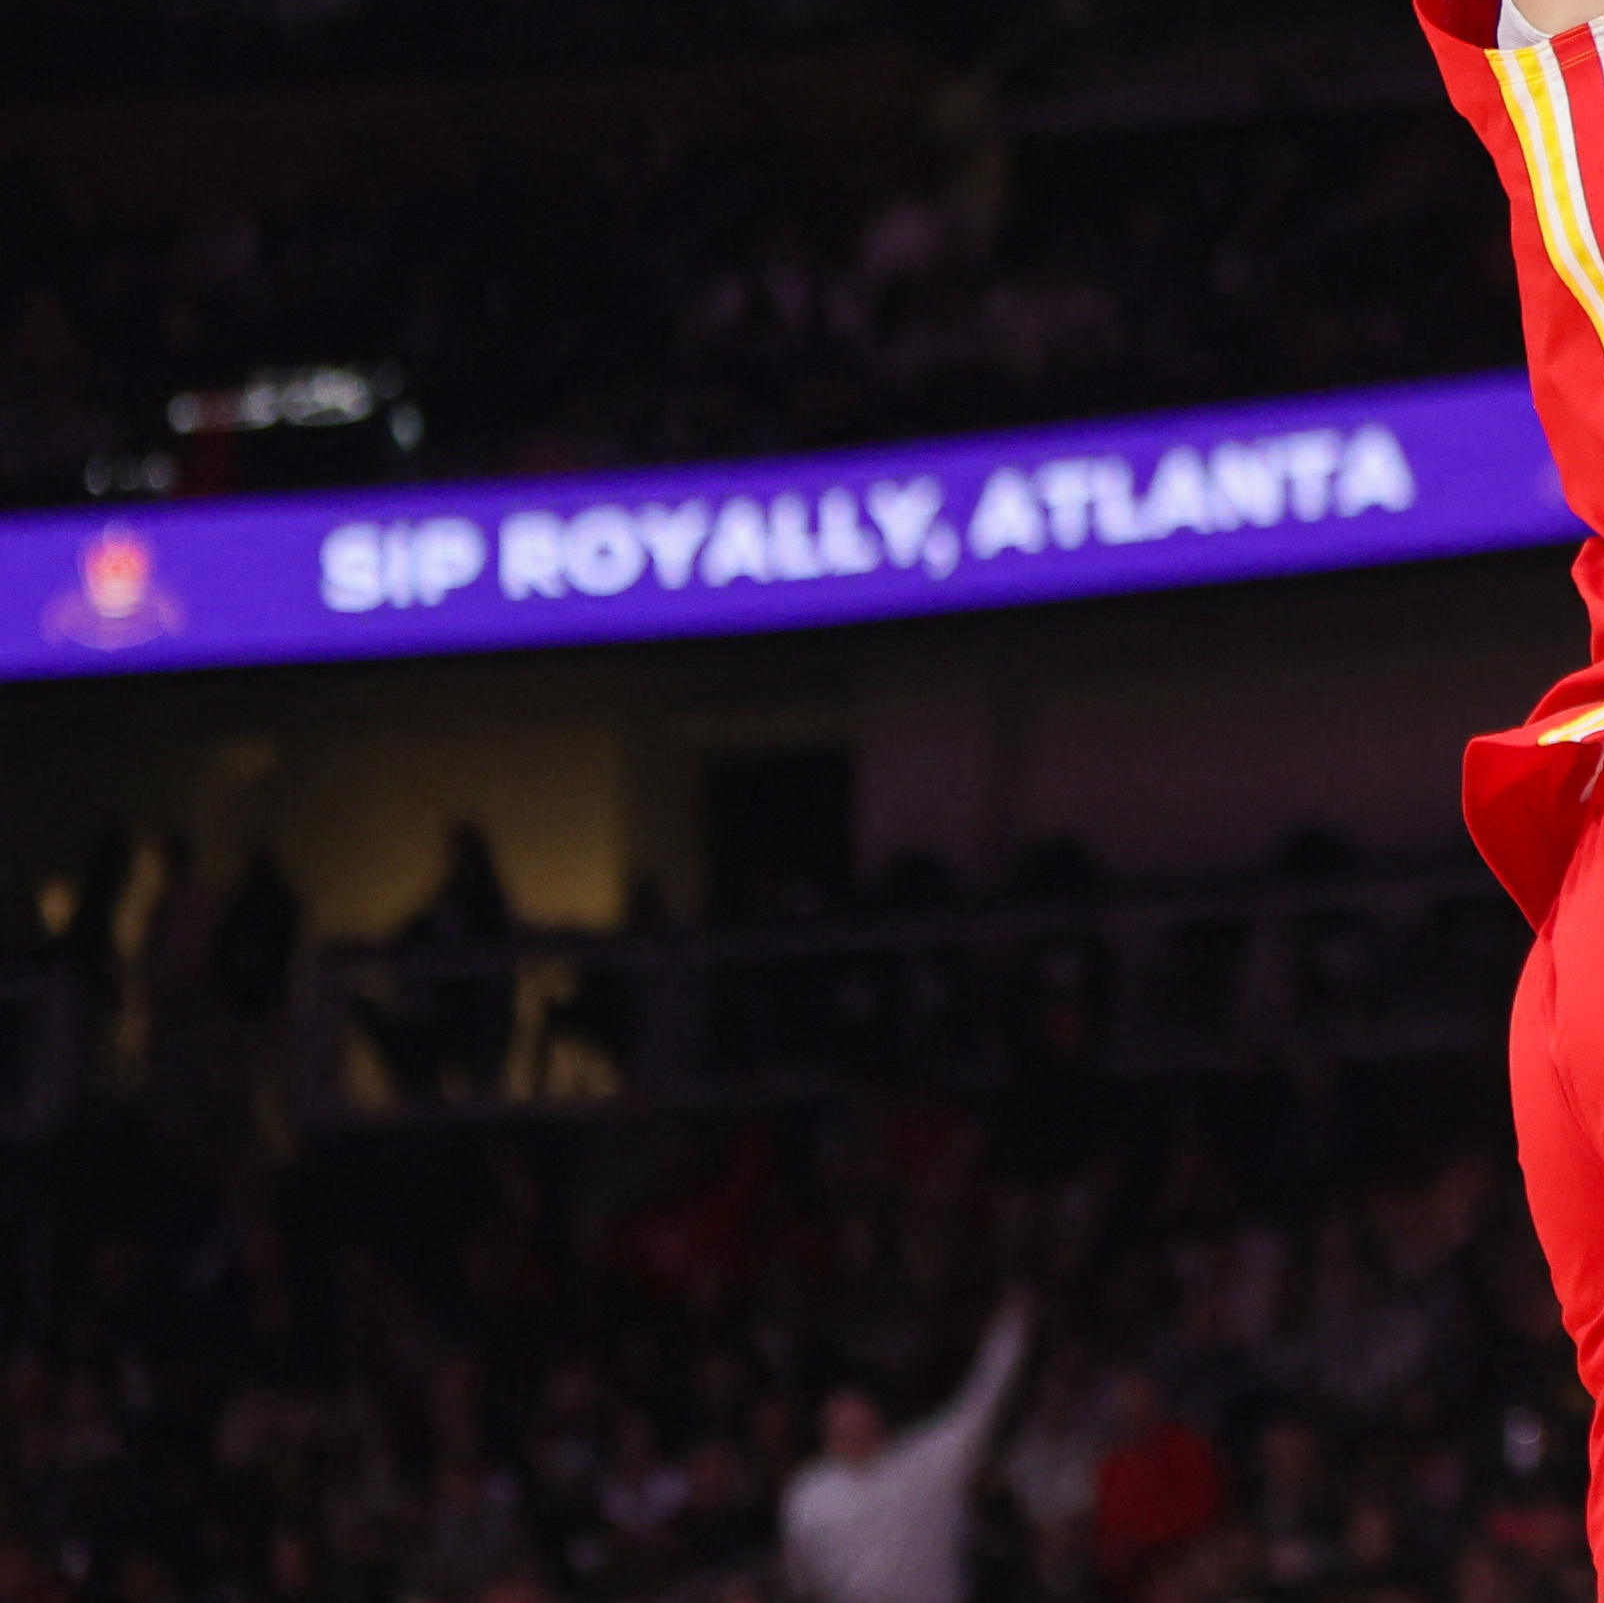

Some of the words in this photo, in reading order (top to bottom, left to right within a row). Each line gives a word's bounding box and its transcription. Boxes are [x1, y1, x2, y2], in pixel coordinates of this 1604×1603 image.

[319, 518, 487, 613] SIP
[498, 477, 960, 602] ROYALLY,
[967, 425, 1415, 560] ATLANTA
